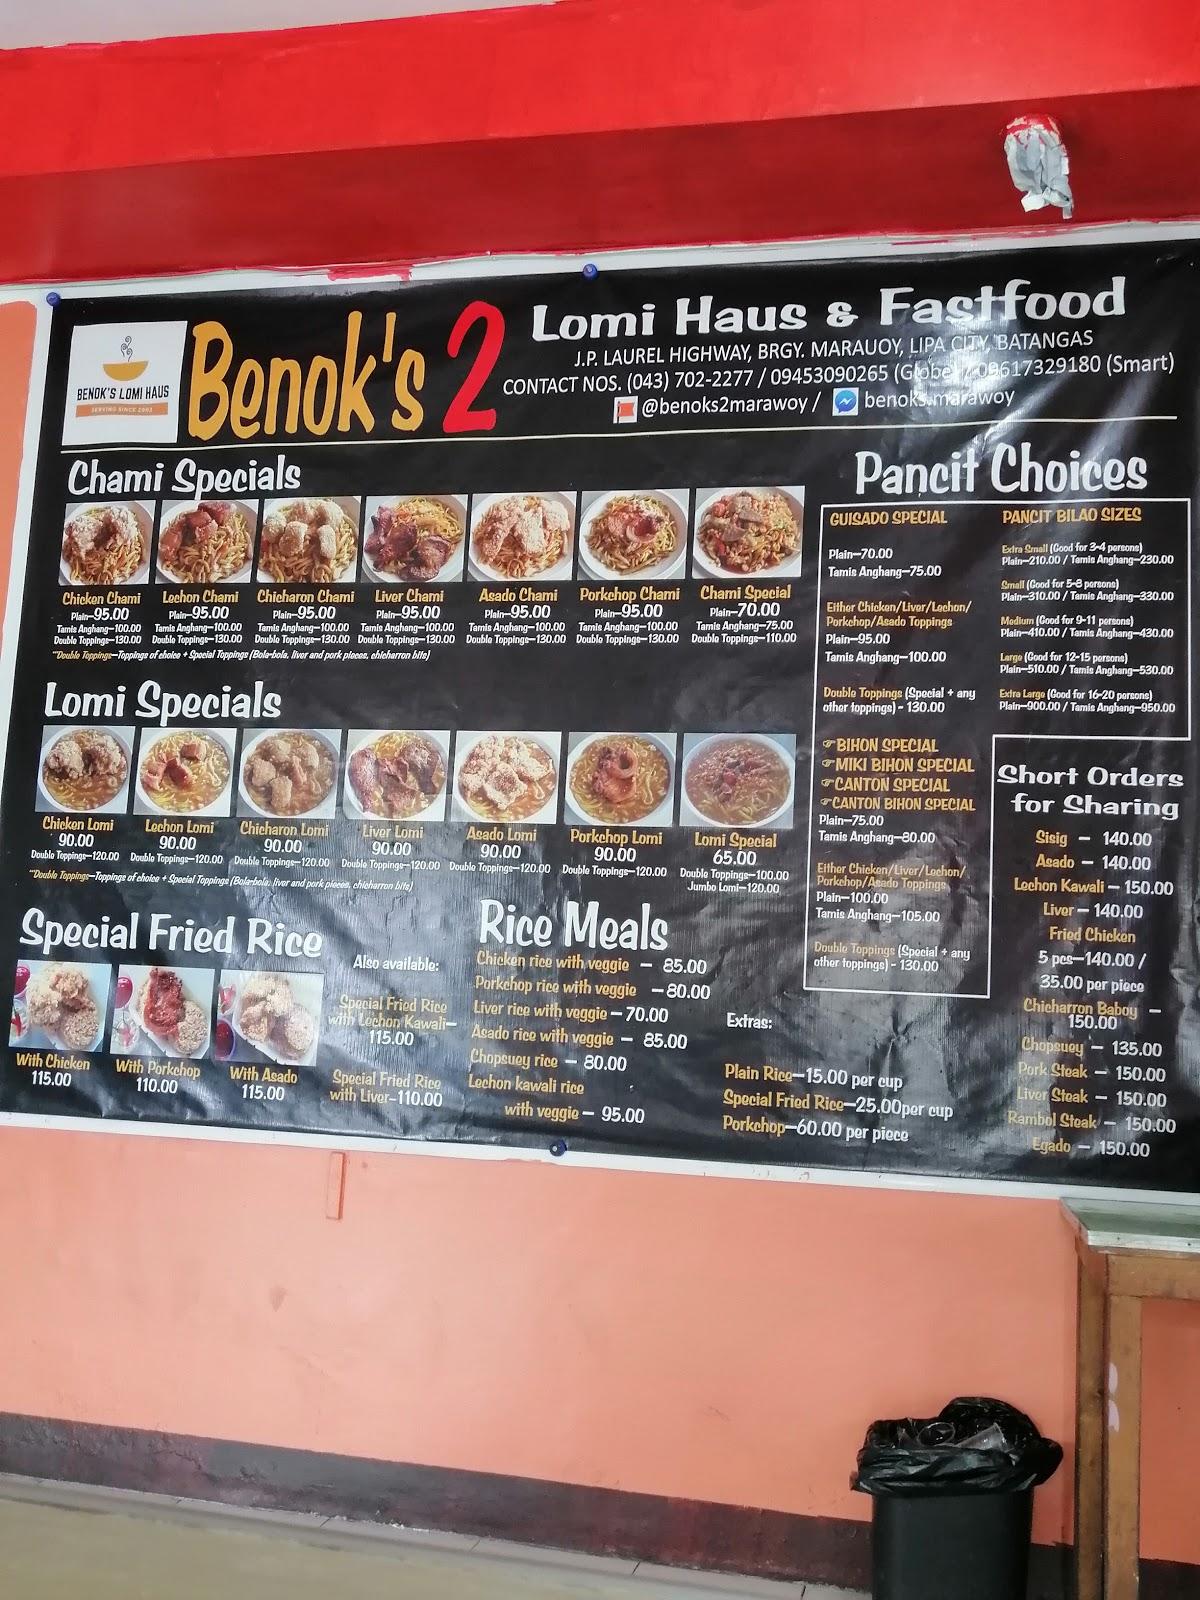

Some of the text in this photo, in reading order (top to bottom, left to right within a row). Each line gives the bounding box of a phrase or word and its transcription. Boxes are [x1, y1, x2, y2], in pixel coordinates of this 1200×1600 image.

[532, 276, 1126, 341] Lomi Haus & Fastfood
[574, 351, 598, 368] J.P.
[604, 348, 664, 366] LAUREL
[670, 344, 752, 364] HIGHWAY,
[759, 343, 804, 360] BRGY.
[811, 337, 905, 360] MARAUOY,
[910, 338, 944, 354] LIPA
[998, 330, 1093, 350] BATANGAS
[188, 300, 506, 440] Benok's 2
[503, 376, 579, 395] CONTACT
[583, 375, 622, 392] NOS.
[627, 373, 669, 393] (043)
[674, 369, 753, 388] 702-2277
[771, 365, 888, 386] 09453090265
[977, 355, 1100, 377] 09617329180
[1106, 352, 1175, 376] (Smart)
[77, 385, 169, 400] BENOK'S LOMI HAUS
[642, 393, 808, 416] @benoks2marawoy
[865, 390, 1015, 409] benoks.marawoy
[855, 442, 1148, 495] Pancit Choices
[68, 455, 300, 500] Chami Specials
[830, 510, 947, 526] GUISADO SPECIAL
[1003, 507, 1142, 524] PANCIT BILAO SIZES
[63, 592, 141, 606] Chicken Chami
[162, 590, 239, 604] Lechon Chami
[257, 589, 355, 603] Chicharon Chami
[375, 589, 444, 603] Liver Chami
[479, 588, 557, 601] Asado Chami
[579, 586, 680, 604] Porkchop Chami
[701, 584, 791, 601] Chami Special
[696, 621, 720, 630] Tamis
[1001, 615, 1133, 627] Medium (Good for 9-11 persons)
[1000, 652, 1128, 664] Large (Good for 12-15 persons)
[823, 687, 856, 698] Double
[859, 687, 902, 700] Toppings
[905, 687, 944, 700] (Special
[957, 690, 976, 700] any
[45, 680, 281, 727] Lomi Specials
[836, 738, 939, 753] BIHON SPECIAL
[836, 758, 975, 772] MIKI BIHON SPECIAL
[997, 765, 1184, 787] Short Orders
[834, 777, 950, 792] CANTON SPECIAL
[832, 797, 976, 811] CANTON BIHON SPECIAL
[1011, 793, 1179, 821] for Sharing
[42, 816, 114, 831] Chicken Lomi
[145, 819, 214, 834] Lechon Lomi
[240, 821, 329, 837] Chicharon Lomi
[362, 825, 423, 839] Liver Lomi
[466, 826, 536, 841] Asado Lomi
[570, 829, 662, 845] Porkchop Lomi
[1035, 830, 1152, 846] Sisig 140.00
[58, 834, 94, 848] 90.00
[159, 836, 196, 850] 90.00
[263, 838, 302, 853] 90.00
[372, 841, 411, 856] 90.00
[694, 832, 777, 849] Lomi Special
[480, 844, 521, 859] 90.00
[594, 847, 636, 862] 90.00
[713, 850, 757, 865] 65.00
[1036, 854, 1151, 870] Asado 140.00
[687, 883, 716, 892] Jumbo
[1014, 877, 1174, 895] Lechon Kawali 150.00
[19, 907, 323, 958] Special Fried Rice
[479, 899, 668, 951] Rice Meals
[1050, 926, 1136, 943] Fried Chicken
[353, 954, 439, 972] Also available:
[476, 950, 706, 974] Chicken rice with veggie 85.00
[475, 975, 532, 995] Porkchop
[536, 979, 559, 993] rice
[563, 979, 591, 994] with
[595, 983, 636, 999] veggie
[1040, 975, 1144, 994] 35.00 per piece
[727, 1012, 772, 1029] Extras:
[1021, 1036, 1162, 1057] Chopsuey 135.00
[16, 1053, 90, 1071] With Chicken
[116, 1059, 200, 1079] With Porkchop
[31, 1071, 71, 1087] 115.00
[230, 1066, 297, 1084] With Asado
[136, 1078, 177, 1094] 110.00
[242, 1084, 284, 1101] 115.00
